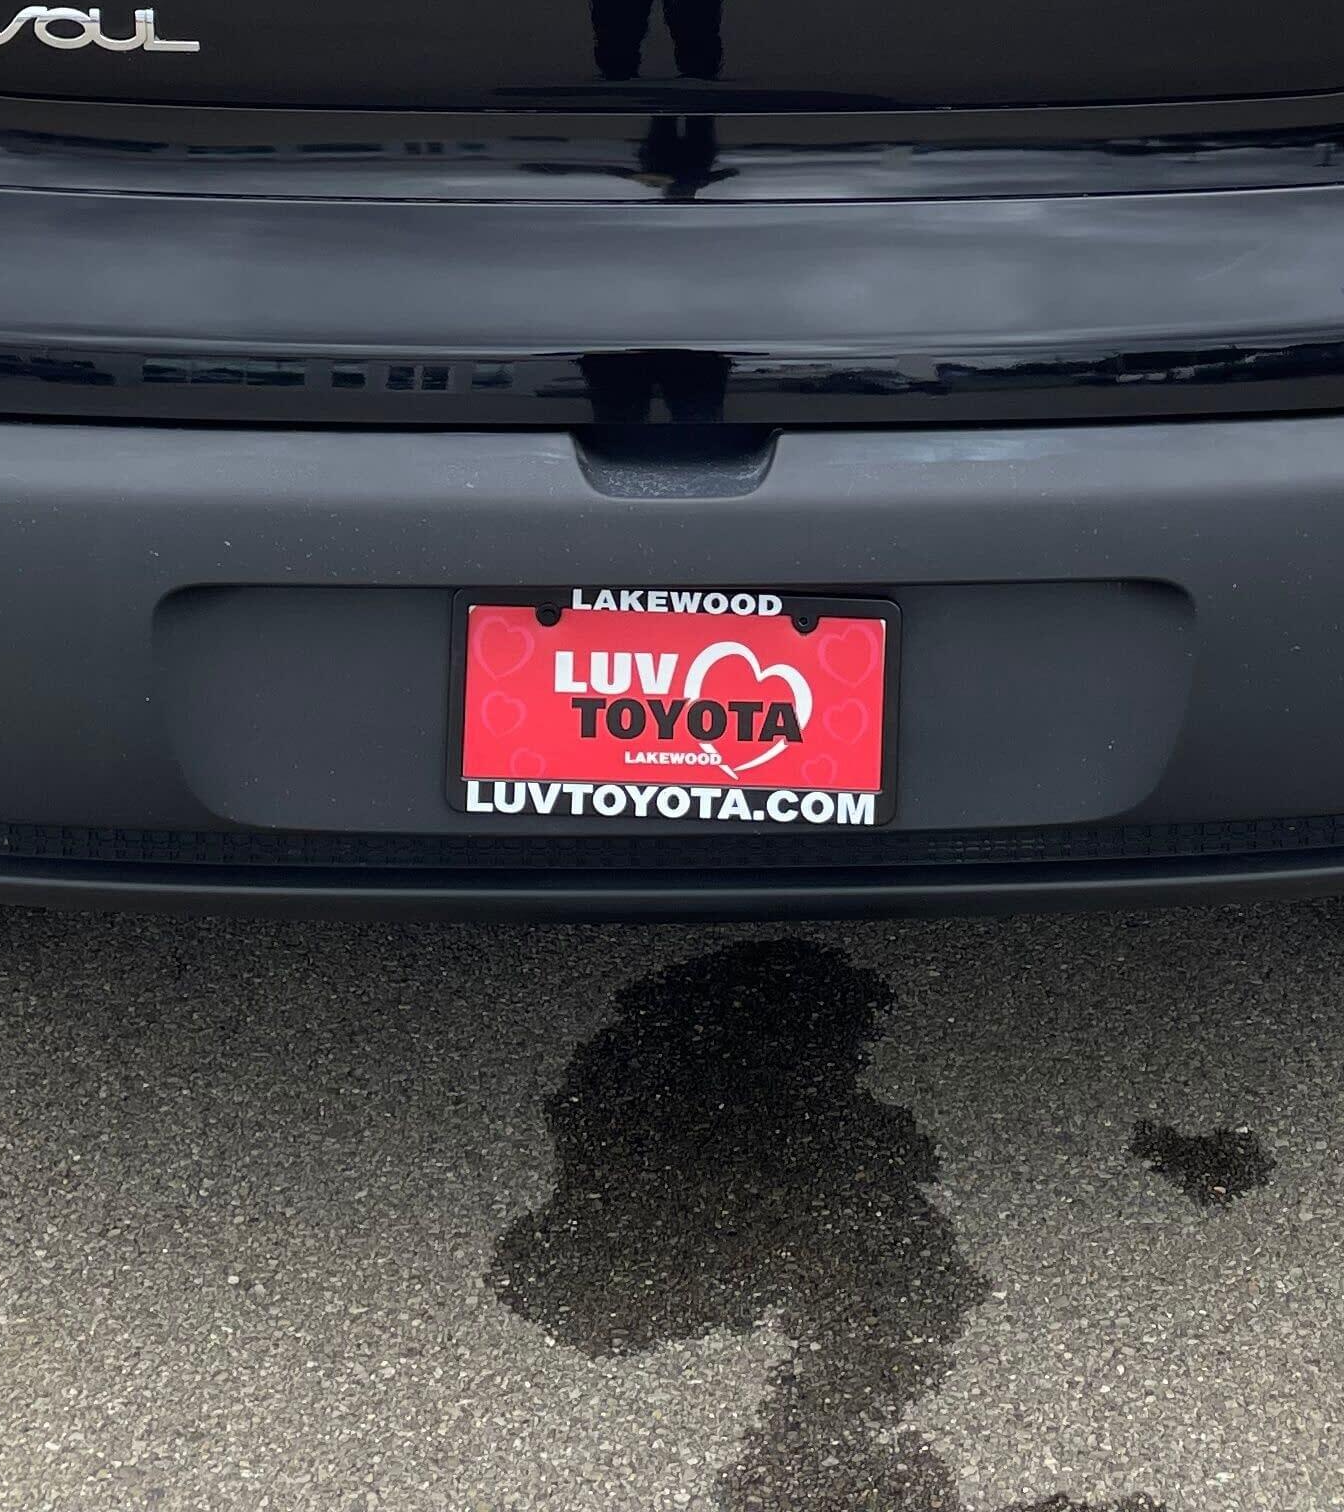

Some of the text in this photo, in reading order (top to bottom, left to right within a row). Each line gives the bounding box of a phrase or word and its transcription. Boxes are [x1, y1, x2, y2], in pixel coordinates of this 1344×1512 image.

[572, 588, 783, 617] LAKEWOOD
[554, 650, 680, 696] LUV
[571, 697, 803, 744] TOYOTA
[624, 751, 722, 767] LAKEWOOD
[466, 779, 876, 827] LUVTOYOTA.COM
